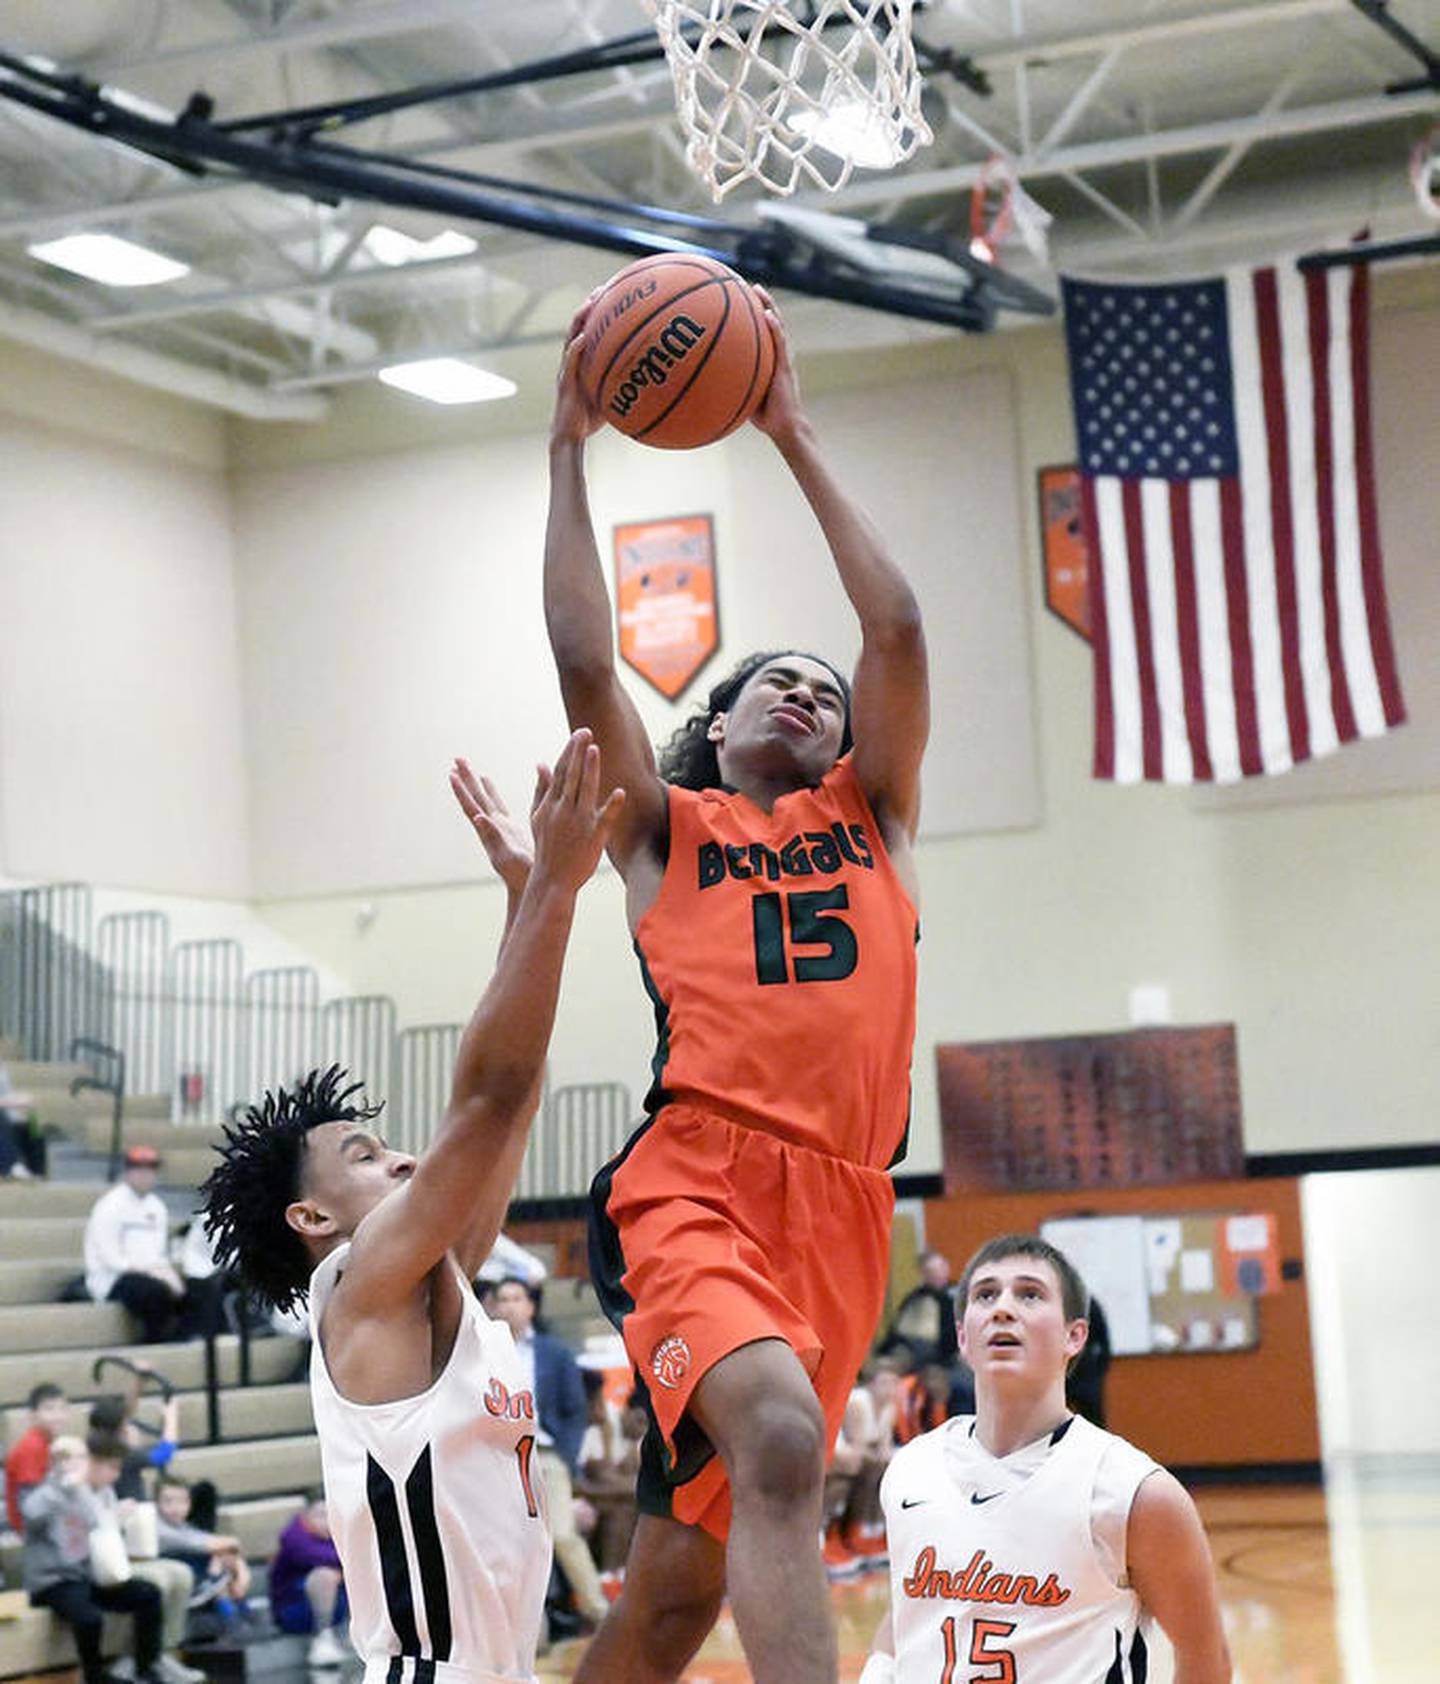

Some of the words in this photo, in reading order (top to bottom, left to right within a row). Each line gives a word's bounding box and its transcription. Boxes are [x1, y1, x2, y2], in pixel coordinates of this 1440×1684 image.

[610, 314, 706, 417] Wilson
[752, 883, 859, 986] 15
[903, 1545, 1071, 1607] Indians
[940, 1616, 1017, 1684] 15
